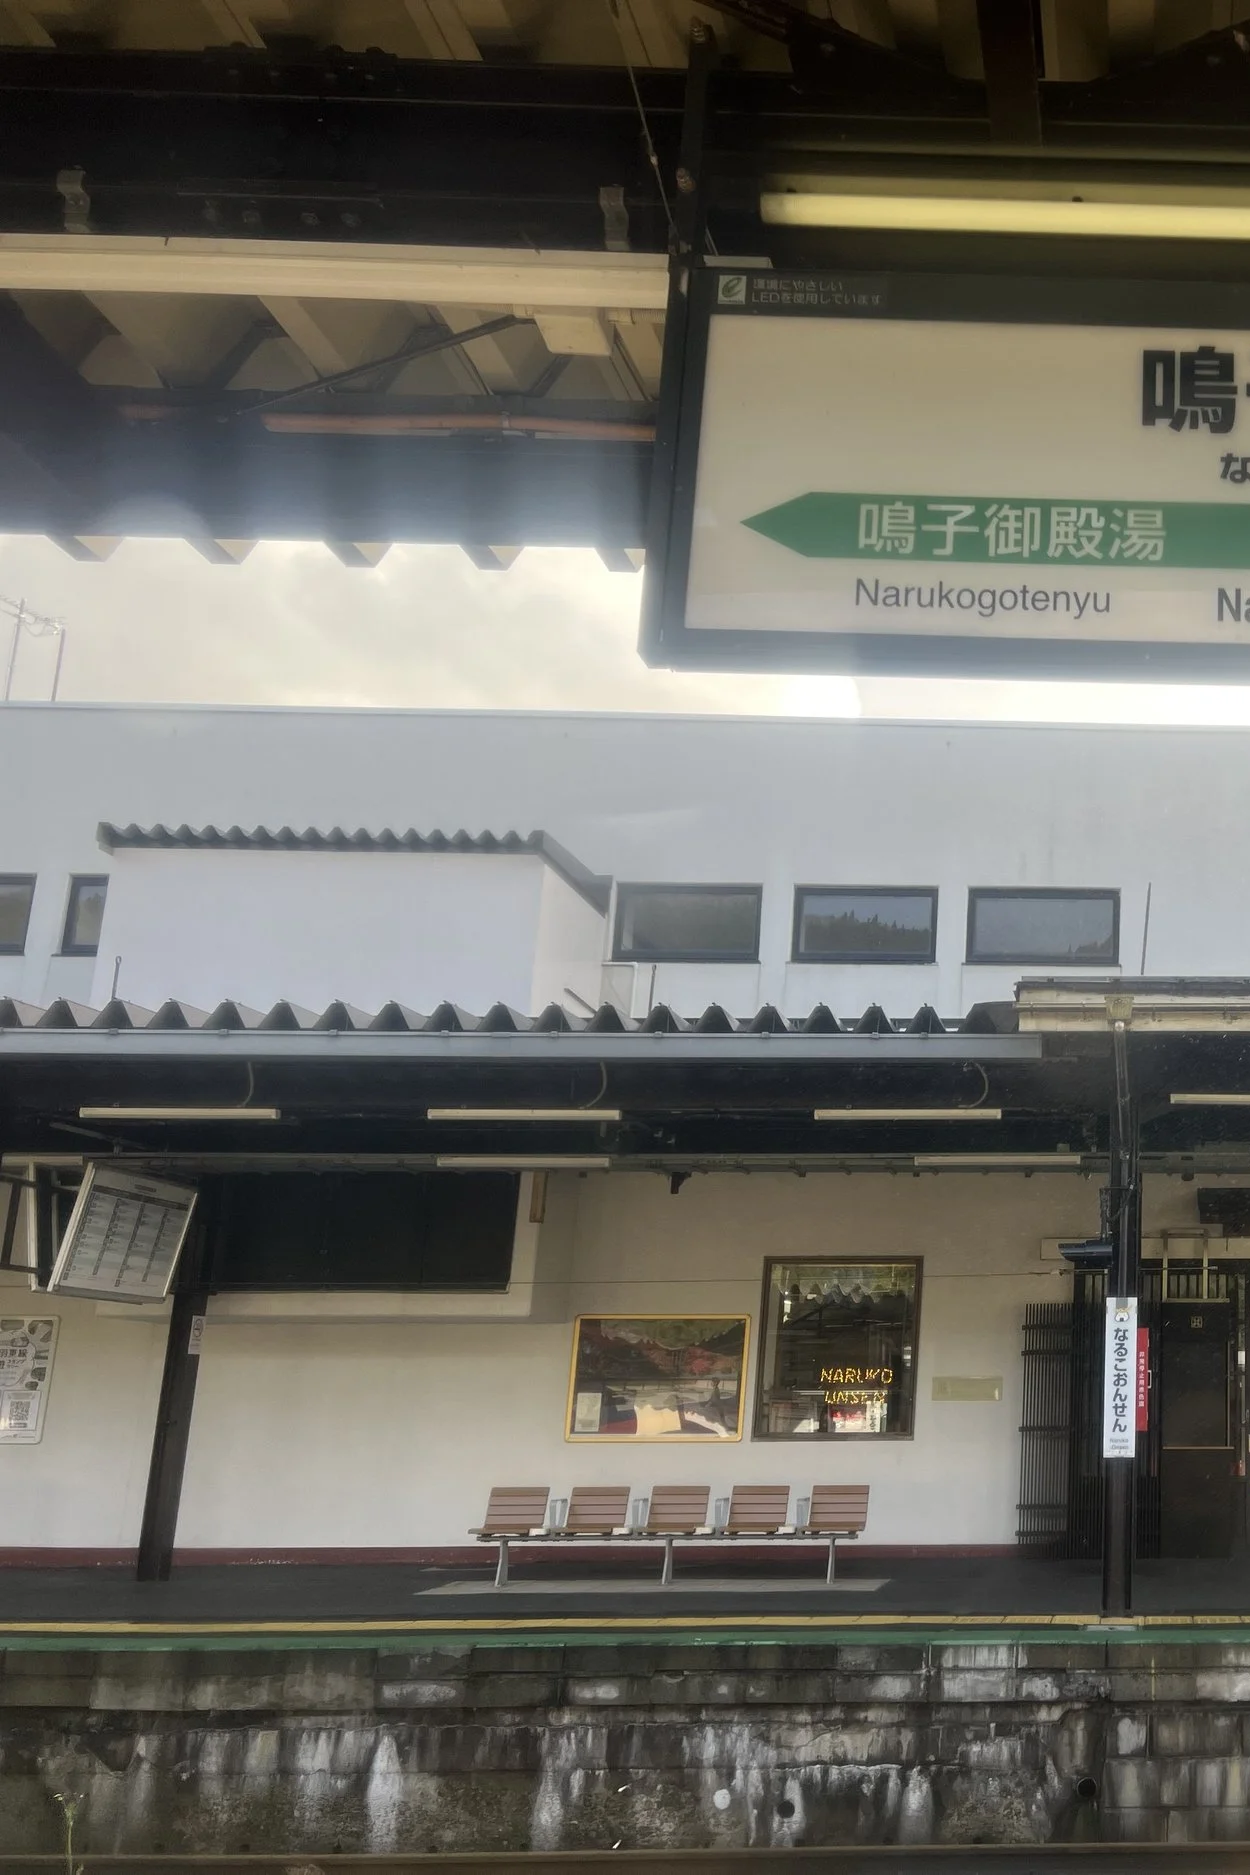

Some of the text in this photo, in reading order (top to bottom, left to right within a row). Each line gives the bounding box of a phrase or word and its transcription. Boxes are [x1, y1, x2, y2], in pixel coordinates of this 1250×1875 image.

[751, 291, 882, 305] LEDを使用しています
[857, 502, 1167, 562] 鳴子御殿湯
[855, 578, 1112, 619] Narukogotenyu
[1112, 1327, 1128, 1433] なるこおんせん
